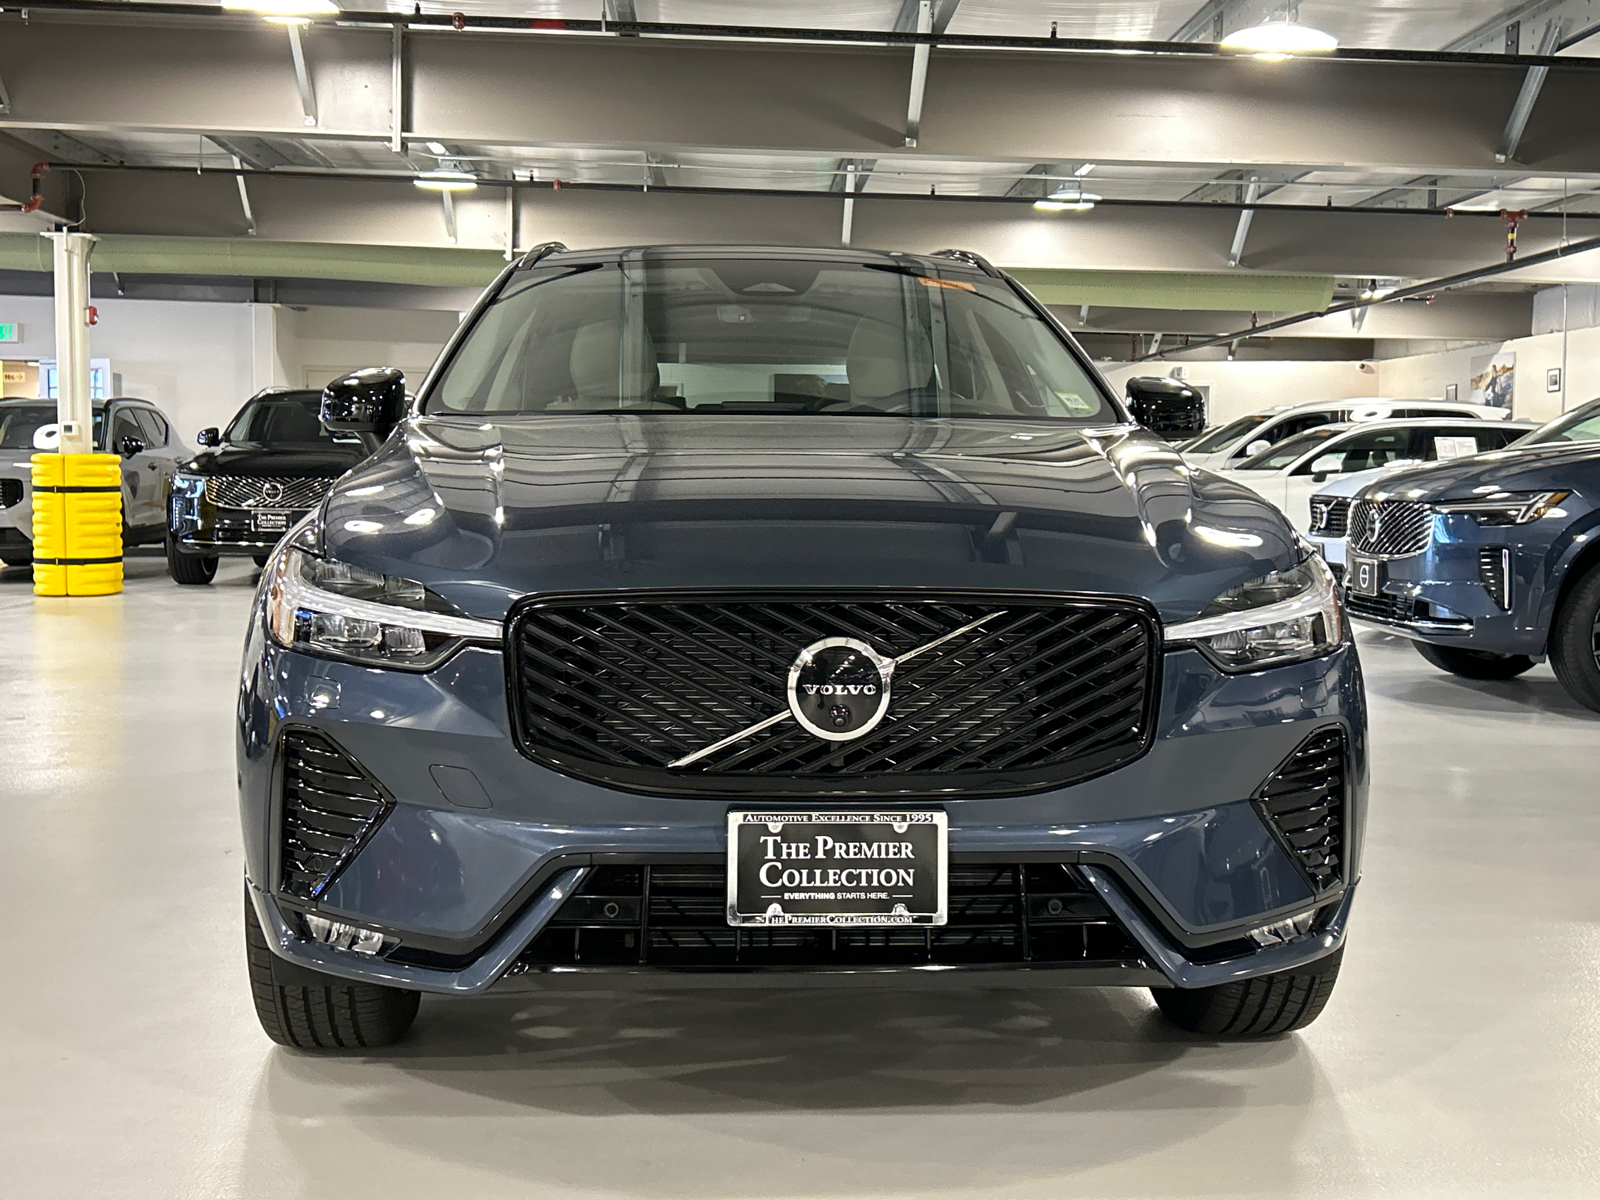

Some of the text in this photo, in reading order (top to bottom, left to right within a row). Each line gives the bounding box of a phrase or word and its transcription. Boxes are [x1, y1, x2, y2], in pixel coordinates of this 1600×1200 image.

[802, 684, 877, 696] VOLVO
[745, 813, 932, 822] AUTOMOTIVE EXCELLENCE SINCE 1995
[760, 835, 915, 860] THE PREMIER
[759, 861, 915, 888] COLLECTION
[783, 892, 835, 900] EVERYTHING
[836, 892, 866, 900] STARTS
